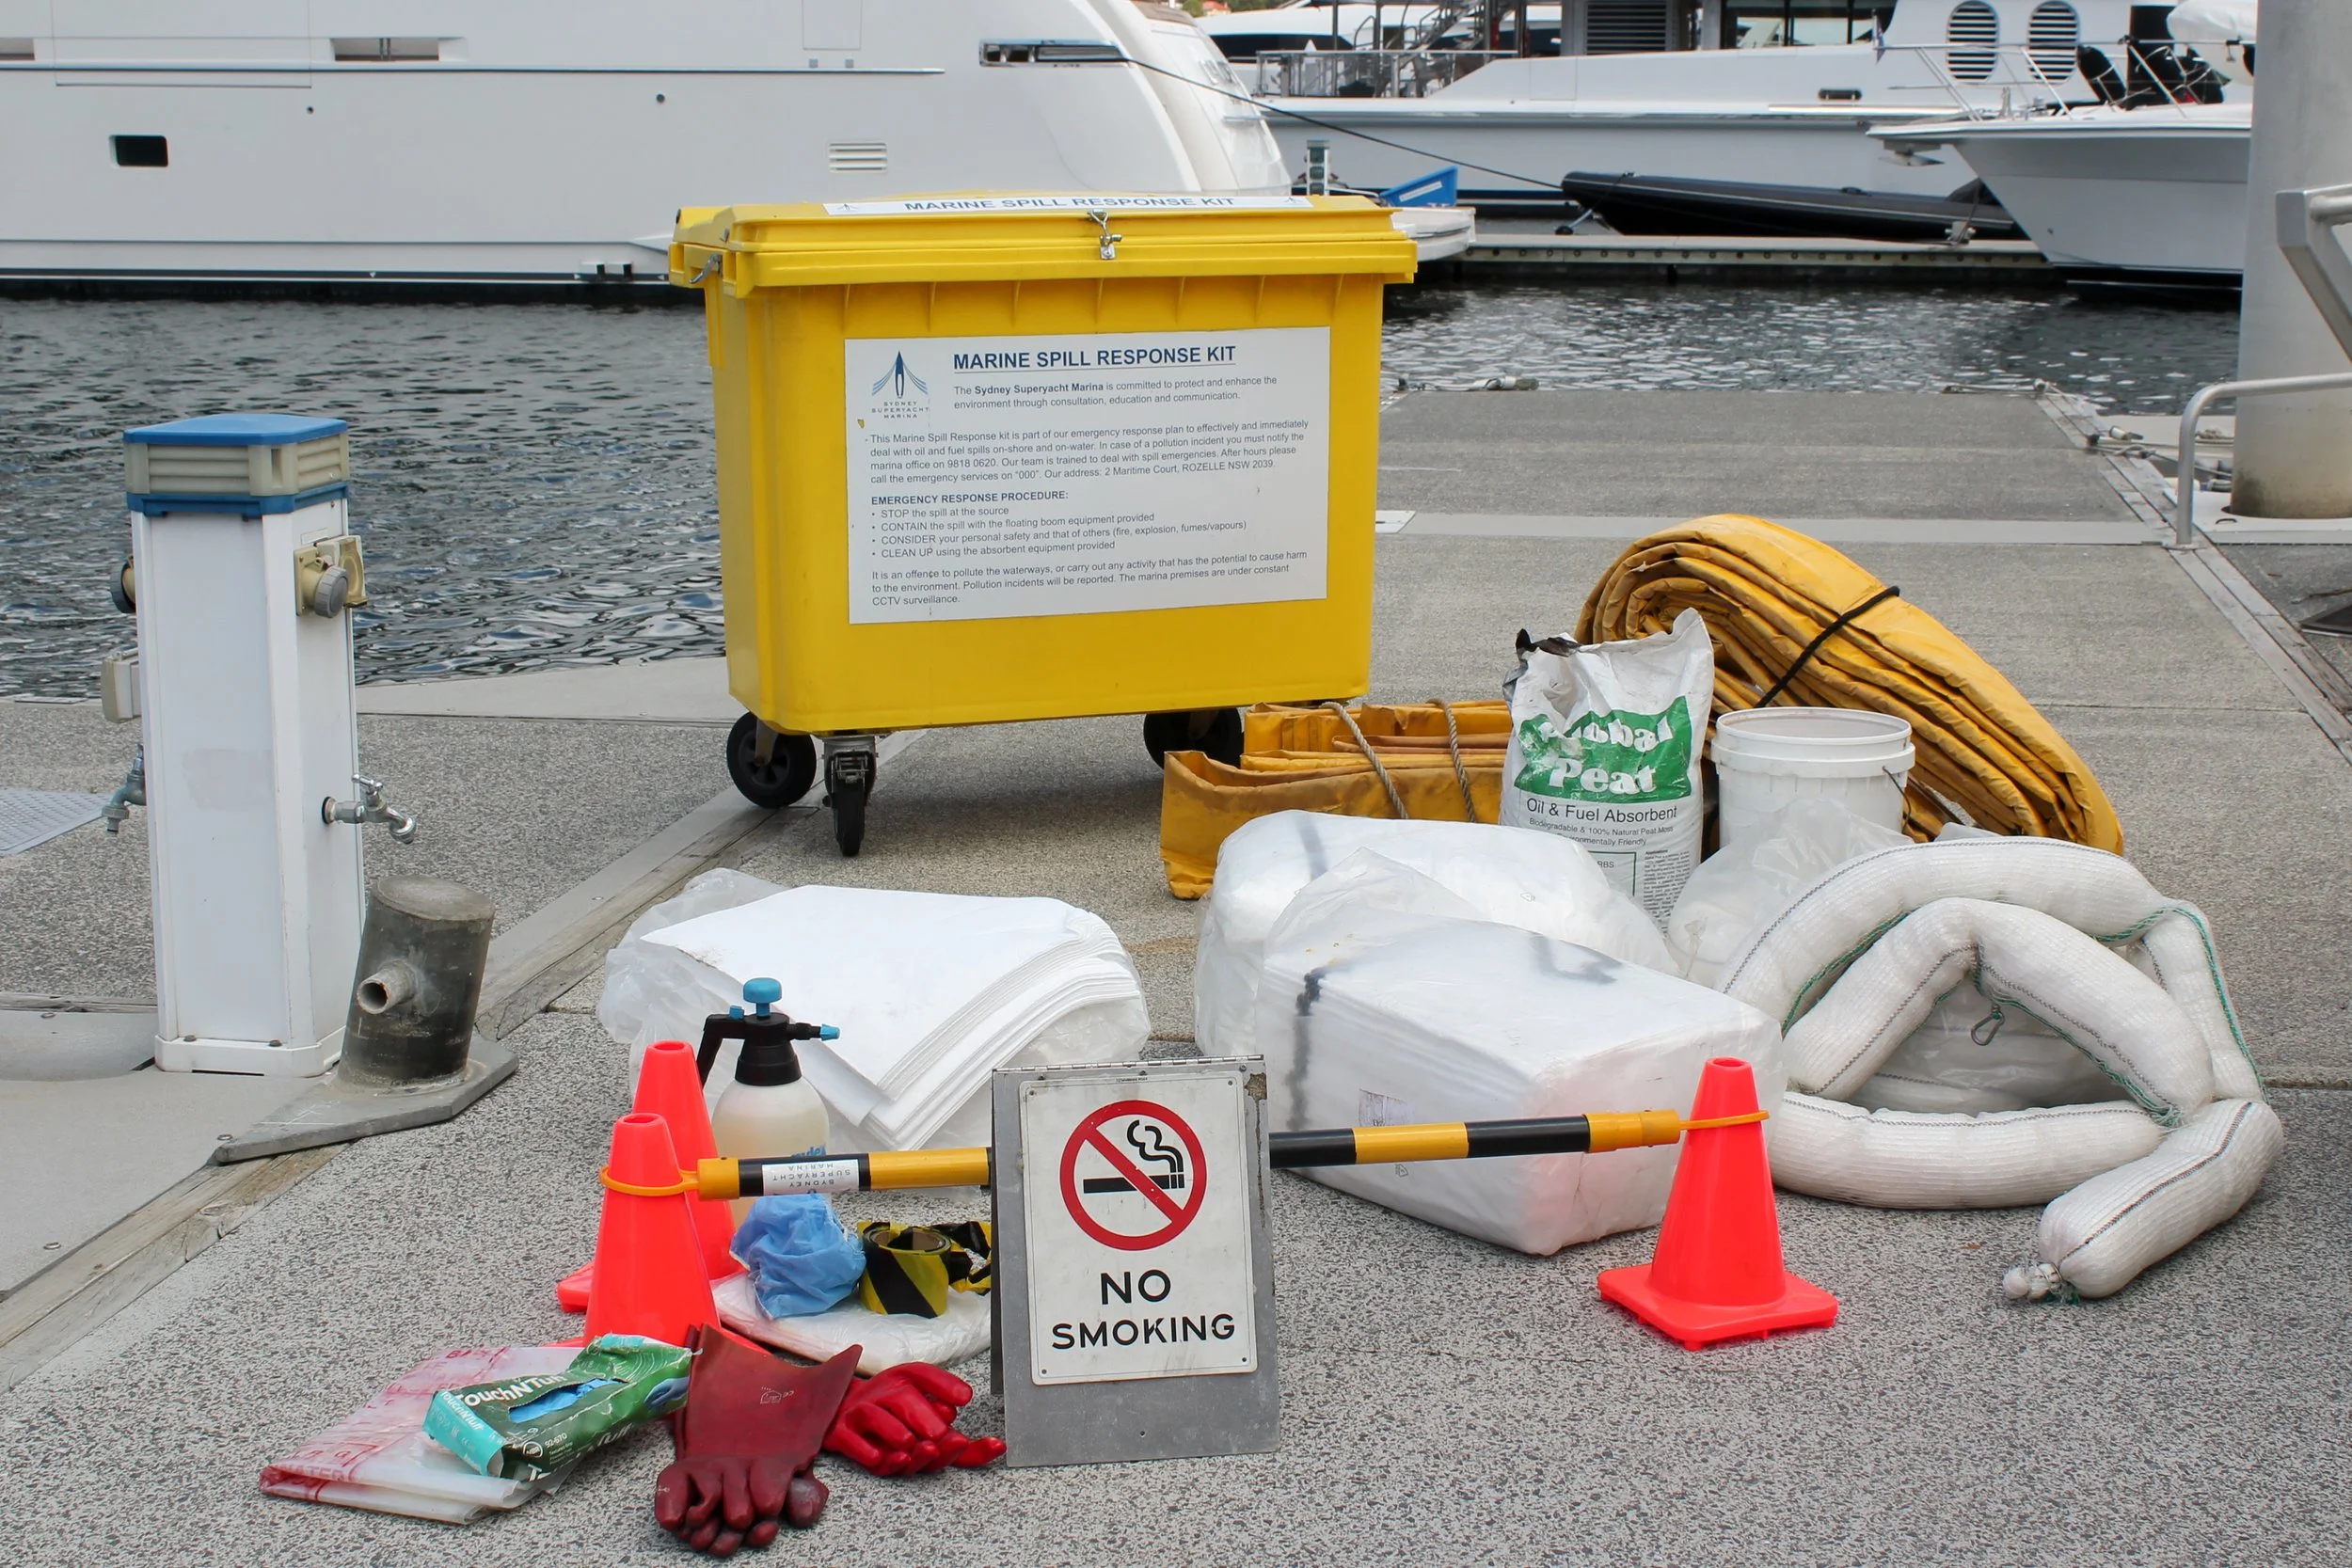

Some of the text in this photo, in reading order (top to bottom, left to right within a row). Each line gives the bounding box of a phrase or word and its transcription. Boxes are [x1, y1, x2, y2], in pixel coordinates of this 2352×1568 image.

[904, 198, 1235, 211] MARINE SPILL RESPONSE KIT
[953, 345, 1236, 370] MARINE SPILL RESPONSE KIT
[953, 375, 1277, 397] The Sydney Superyacht Marina is committed to protect and enhance the
[953, 390, 1240, 409] environment through consultation, education and communication.
[869, 434, 890, 443] This
[893, 433, 925, 443] Marine
[928, 432, 947, 444] Spill
[949, 431, 996, 444] Response
[998, 430, 1009, 439] kit
[1011, 431, 1020, 439] is
[1022, 430, 1040, 441] part
[1041, 429, 1052, 438] of
[1070, 428, 1120, 439] emergency
[1122, 427, 1163, 437] response
[1165, 424, 1184, 436] plan
[1185, 424, 1194, 433] to
[1196, 421, 1239, 434] effectively
[1241, 420, 1257, 430] and
[1259, 419, 1309, 431] immediately
[870, 461, 902, 470] marina
[905, 459, 930, 469] office
[946, 458, 970, 468] 9818
[973, 457, 998, 467] 0620.
[1001, 457, 1019, 467] Our
[1021, 456, 1043, 466] team
[1046, 456, 1054, 465] is
[1056, 454, 1087, 464] trained
[1089, 454, 1098, 463] to
[1100, 453, 1119, 463] deal
[1121, 452, 1139, 462] with
[1141, 451, 1158, 462] spill
[1161, 449, 1218, 462] emergencies.
[1220, 447, 1241, 457] After
[1243, 447, 1266, 455] hours
[1268, 445, 1295, 456] please
[870, 474, 886, 483] call
[889, 473, 904, 483] the
[906, 473, 959, 484] emergency
[961, 471, 998, 482] services
[1043, 468, 1061, 478] Our
[1063, 467, 1102, 478] address:
[1104, 467, 1110, 476] 2
[1113, 465, 1151, 475] Maritime
[1152, 464, 1179, 474] Court,
[1182, 461, 1225, 472] ROZELLE
[1228, 460, 1250, 469] NSW
[1252, 458, 1275, 468] 2039.
[871, 489, 1068, 506] EMERGENCY RESPONSE PROCEDURE:
[881, 507, 1009, 518] STOP the spill at the source
[881, 512, 1154, 531] CONTAIN the spill with the floating boom equipment provided
[881, 533, 936, 546] CONSIDER
[938, 535, 960, 545] your
[961, 532, 1001, 544] personal
[1003, 531, 1030, 542] safety
[1033, 531, 1050, 539] and
[1052, 530, 1069, 538] that
[1071, 529, 1080, 537] of
[1082, 528, 1110, 537] others
[1135, 524, 1178, 536] explosion,
[881, 540, 1115, 558] CLEAN UP using the absorbent equipment provided
[871, 584, 881, 593] to
[883, 583, 898, 593] the
[900, 581, 960, 593] environment.
[962, 578, 1002, 590] Pollution
[1004, 578, 1044, 588] incidents
[1045, 576, 1060, 585] will
[1063, 576, 1074, 585] be
[1076, 574, 1116, 586] reported.
[1118, 573, 1136, 581] The
[1137, 571, 1168, 581] marina
[1169, 568, 1209, 580] premises
[1227, 566, 1252, 576] under
[1253, 563, 1289, 574] constant
[872, 594, 960, 606] CCTV surveillance.
[1549, 757, 1657, 795] Peat
[1526, 798, 1677, 823] Oil & Fuel Absorbent
[1529, 817, 1579, 832] Biodegradable
[1612, 828, 1639, 836] Natural
[1641, 827, 1657, 835] Peat
[1658, 826, 1674, 834] Moss
[1618, 837, 1646, 847] Friendly
[772, 1169, 851, 1181] SUPERYACHT
[787, 1163, 834, 1171] MARINA
[789, 1179, 834, 1188] SYDNEY
[1100, 1269, 1171, 1305] NO
[1052, 1313, 1235, 1350] SMOKING
